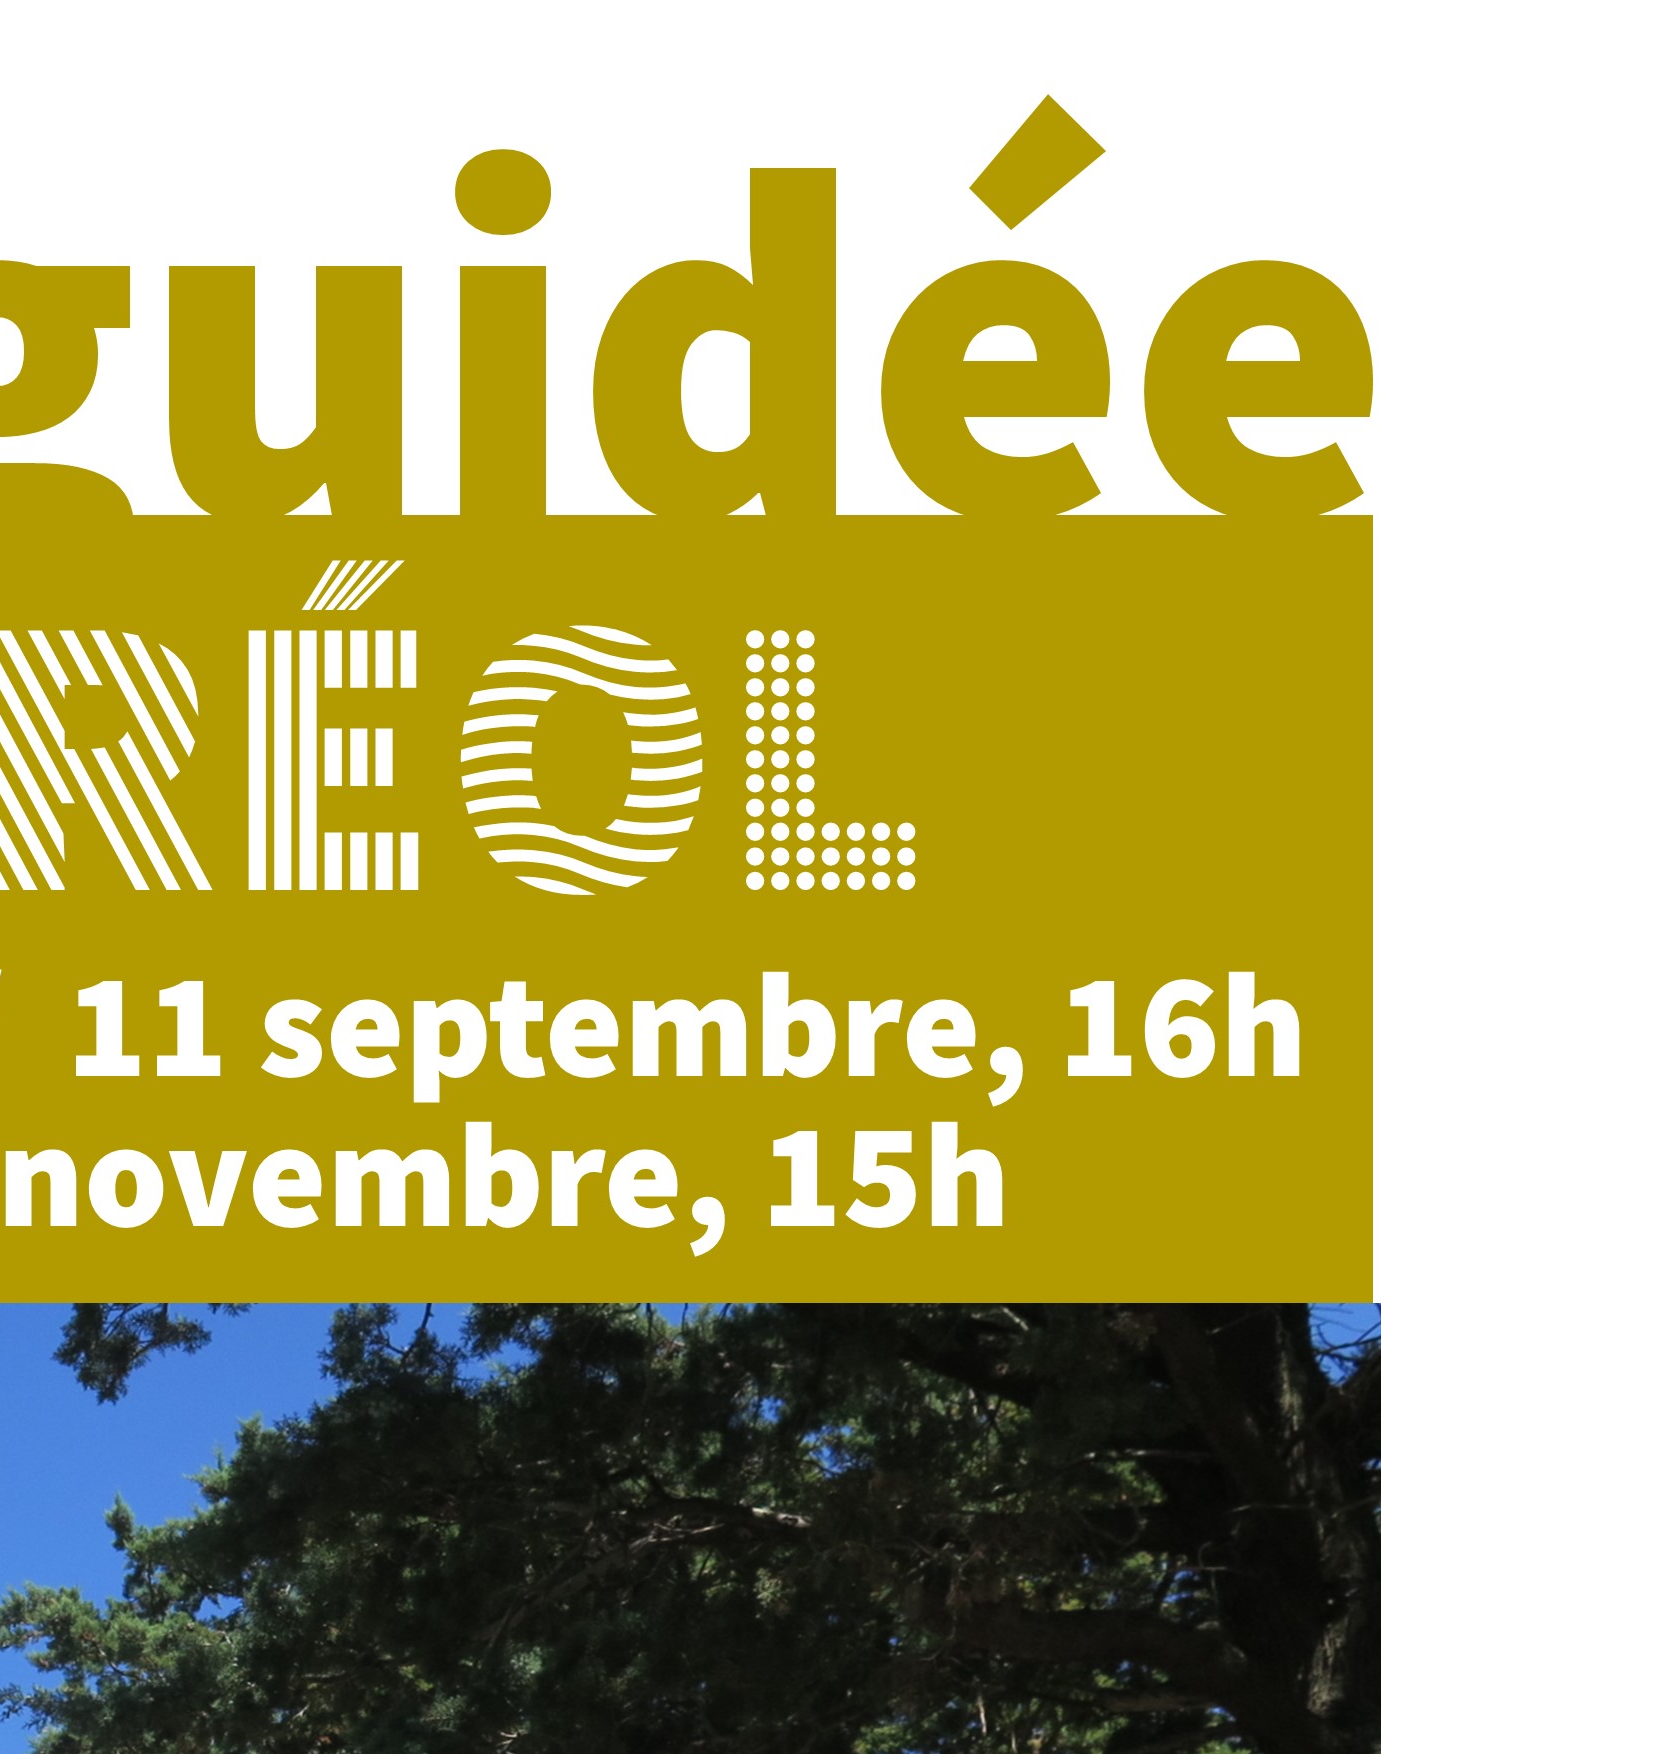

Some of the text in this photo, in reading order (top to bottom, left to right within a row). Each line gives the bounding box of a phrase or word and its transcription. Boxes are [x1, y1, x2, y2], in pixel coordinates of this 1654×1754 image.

[76, 981, 221, 1076] 11
[261, 972, 1023, 1107] septembre,
[1068, 972, 1299, 1078] 16h
[5, 1122, 725, 1257] novembre,
[771, 1122, 1003, 1228] 15h
